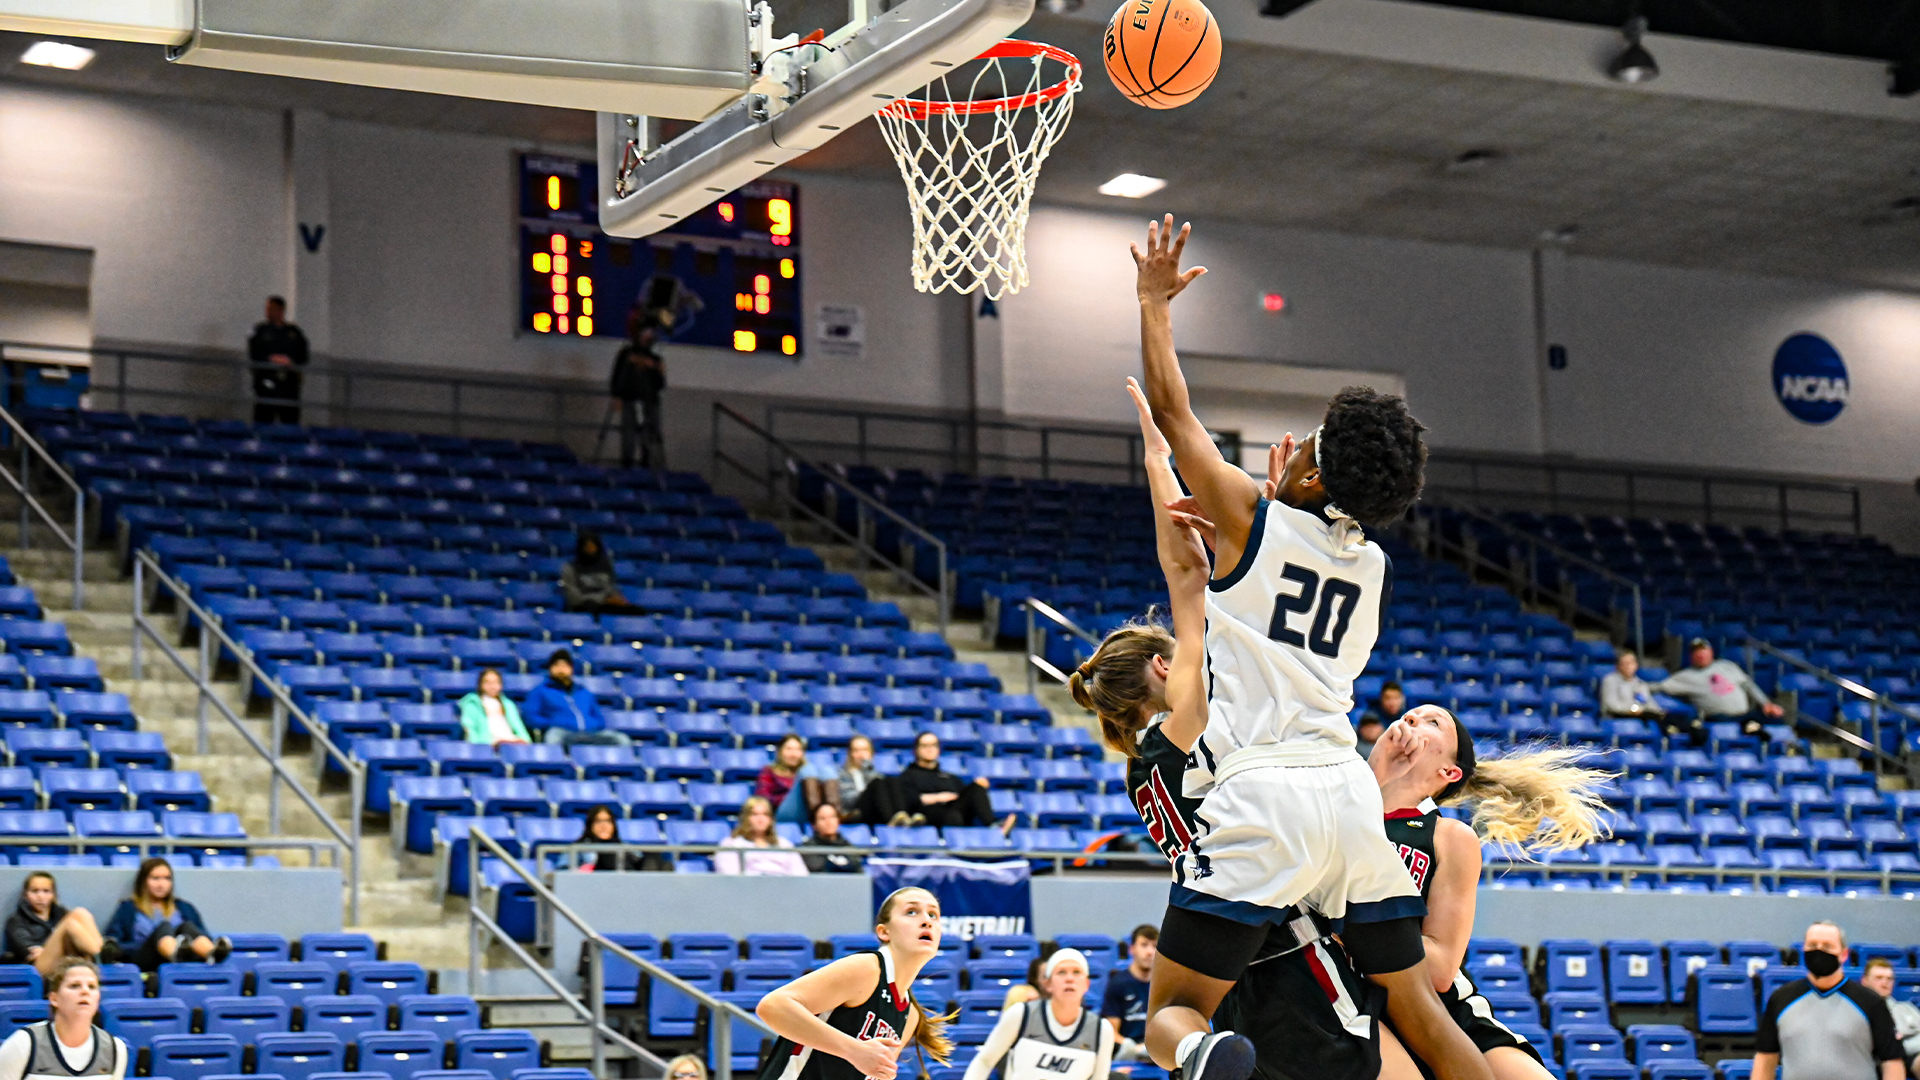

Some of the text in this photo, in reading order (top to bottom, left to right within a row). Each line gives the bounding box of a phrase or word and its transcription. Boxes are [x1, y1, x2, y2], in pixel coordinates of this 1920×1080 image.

[767, 198, 792, 237] 9
[299, 222, 325, 253] V
[1781, 374, 1847, 403] NCAA
[1268, 561, 1362, 659] 20
[1135, 763, 1200, 865] 21
[940, 915, 1026, 941] SKETBALL
[1035, 1052, 1076, 1074] LMU
